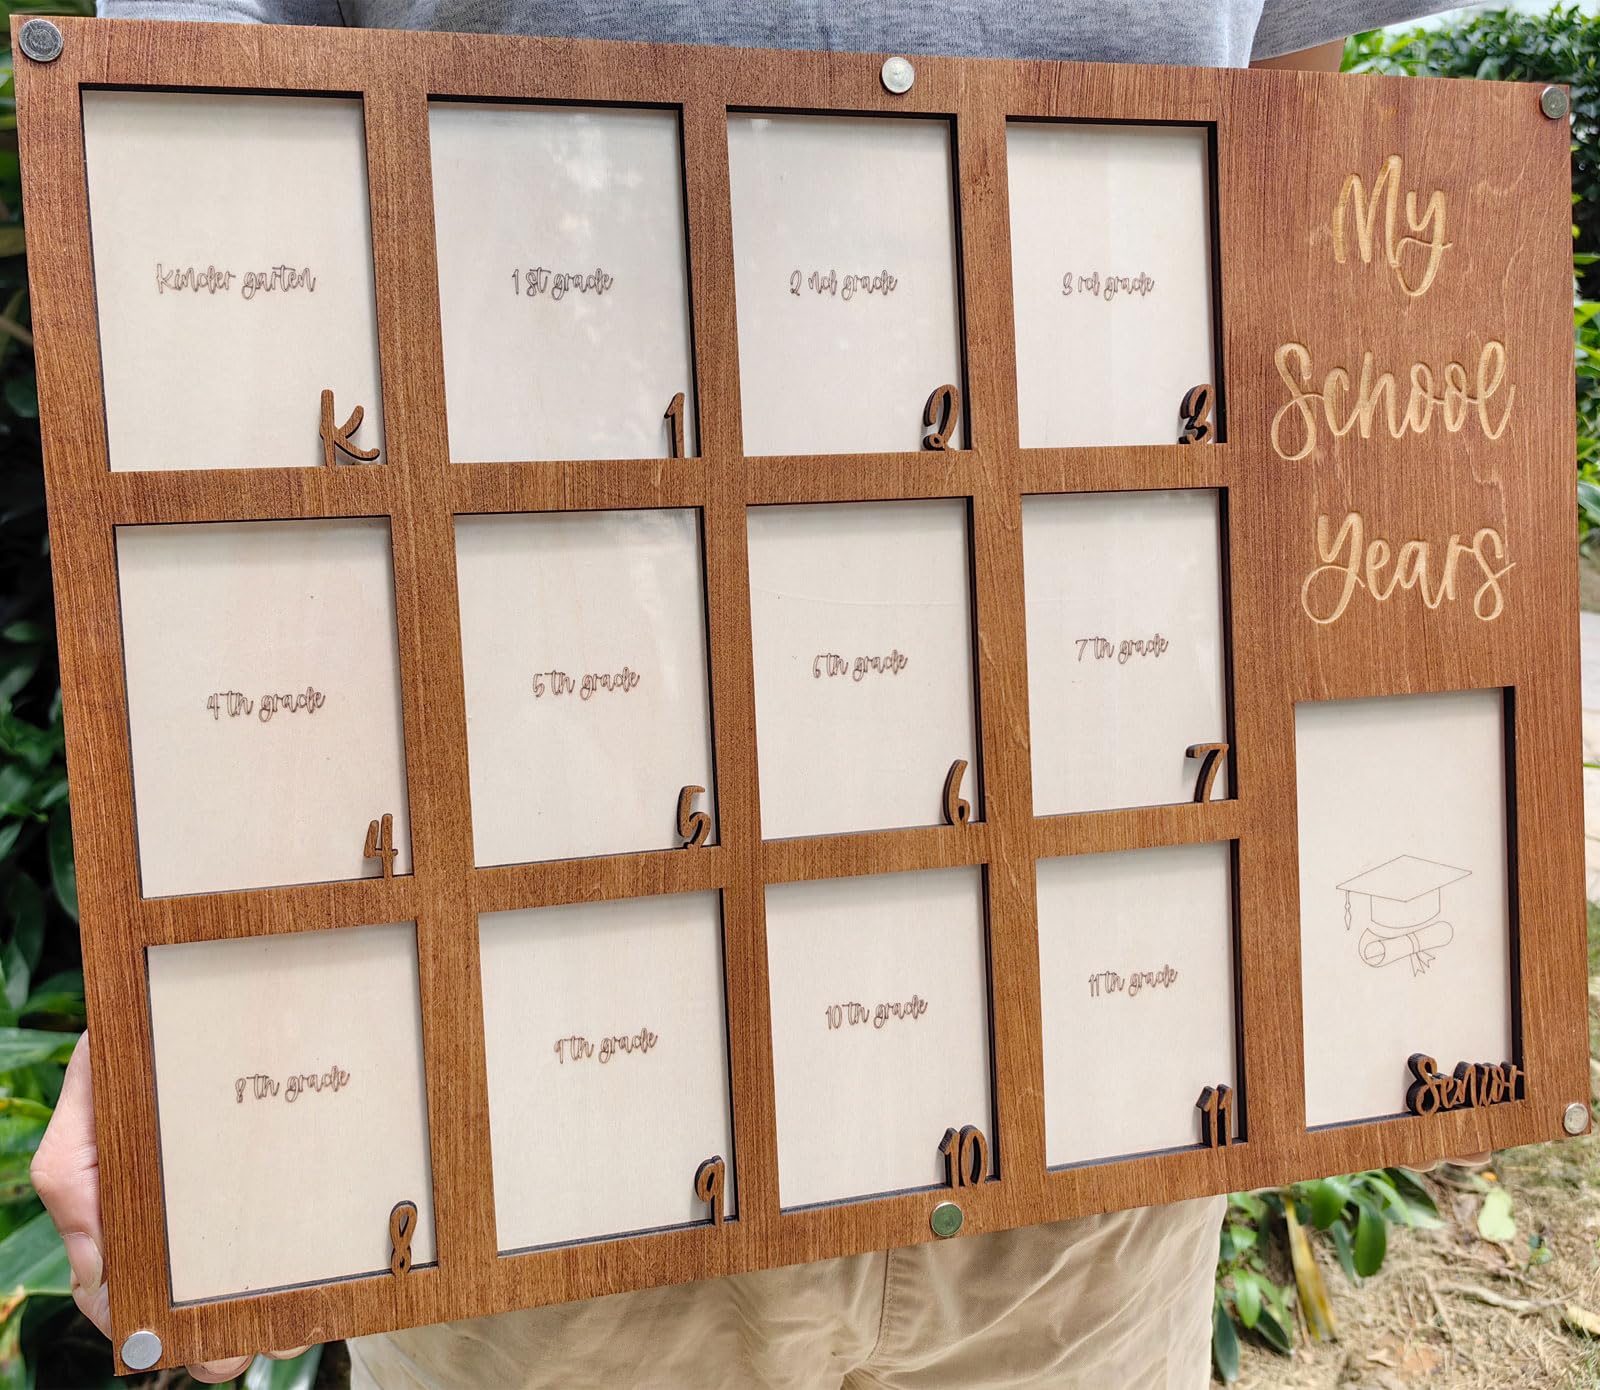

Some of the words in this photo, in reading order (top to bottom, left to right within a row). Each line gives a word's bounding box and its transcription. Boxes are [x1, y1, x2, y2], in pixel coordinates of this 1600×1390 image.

[1333, 154, 1453, 297] My
[551, 267, 613, 301] grade
[841, 269, 898, 301] grade
[1103, 271, 1155, 301] grade
[663, 392, 686, 460] 1
[922, 384, 959, 452] 2
[1179, 383, 1214, 446] 3
[1271, 340, 1517, 460] School
[1301, 511, 1517, 624] Years
[812, 652, 849, 679] 6th
[852, 648, 909, 682] grade
[1075, 636, 1114, 662] 7th
[1117, 633, 1168, 664] grade
[206, 689, 254, 720] 4th
[259, 686, 326, 722] grade
[532, 669, 576, 698] 5th
[579, 666, 640, 700] grade
[943, 759, 971, 826] 6
[1185, 741, 1228, 803] 7
[364, 813, 399, 878] 4
[676, 785, 710, 848] 5
[1088, 970, 1125, 997] 11th
[1128, 963, 1178, 997] grade
[825, 1000, 870, 1030] 10th
[873, 994, 928, 1029] grade
[553, 1036, 595, 1064] 9th
[598, 1027, 658, 1064] grade
[235, 1073, 280, 1103] 8th
[285, 1065, 351, 1103] grade
[1195, 1083, 1233, 1148] 11
[1406, 1053, 1525, 1116] Senior
[937, 1125, 989, 1188] 10
[694, 1154, 726, 1224] 9
[389, 1200, 418, 1277] 8
